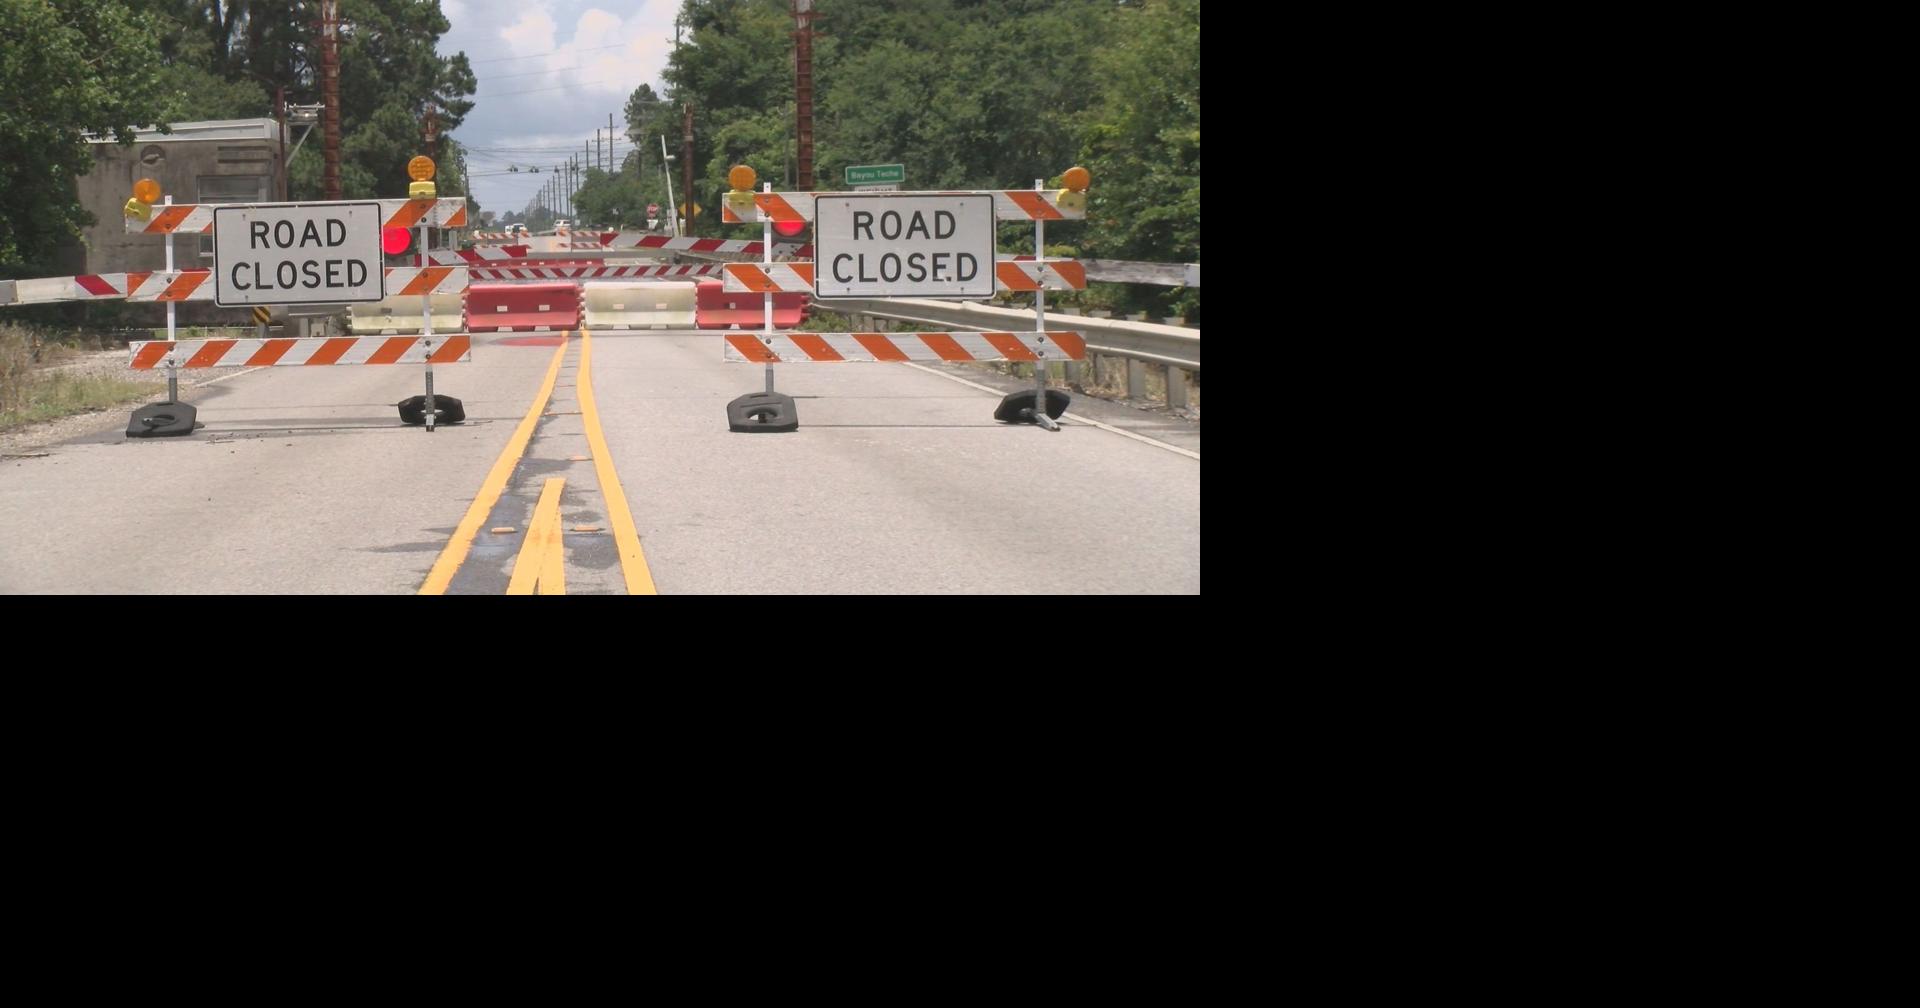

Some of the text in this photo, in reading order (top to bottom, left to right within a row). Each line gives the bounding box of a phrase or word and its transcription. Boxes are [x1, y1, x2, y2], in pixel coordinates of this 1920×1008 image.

[851, 171, 875, 181] Bayou
[250, 218, 347, 249] ROAD
[853, 210, 956, 240] ROAD
[231, 258, 368, 290] CLOSED
[832, 252, 978, 283] CLOSED
